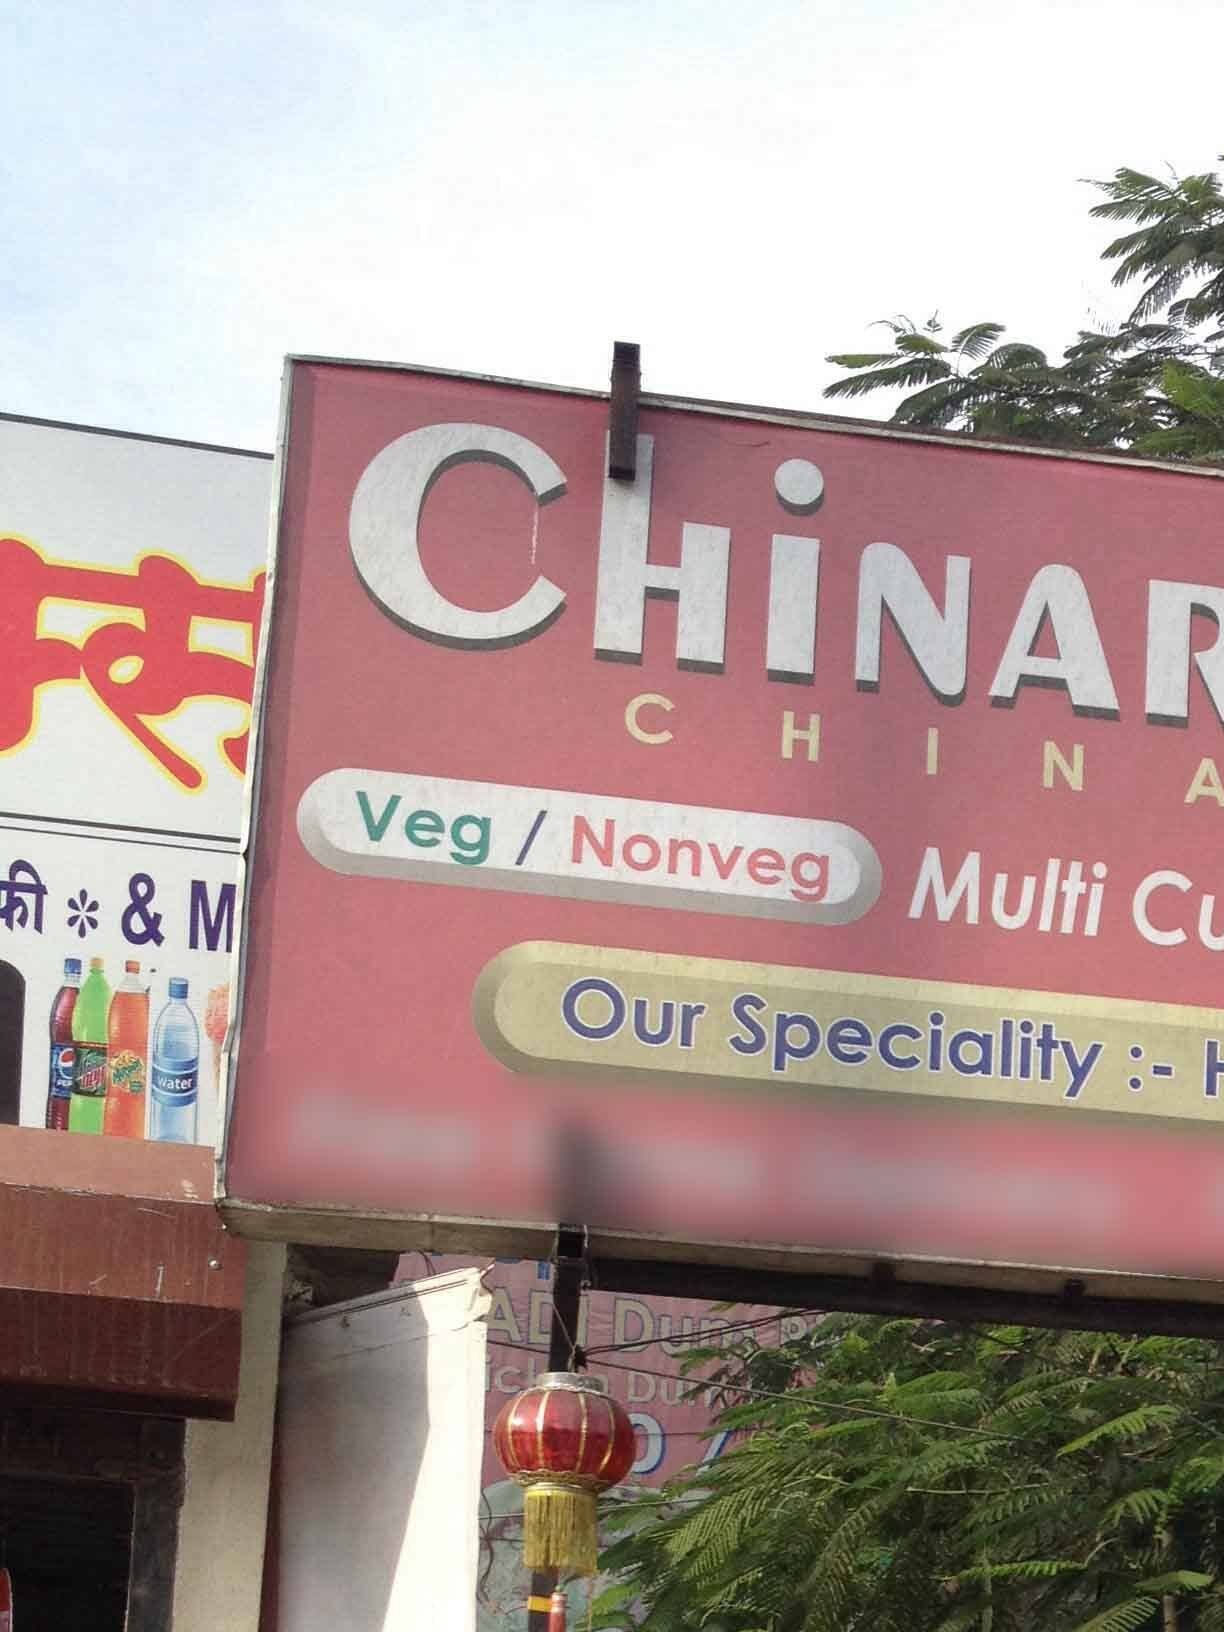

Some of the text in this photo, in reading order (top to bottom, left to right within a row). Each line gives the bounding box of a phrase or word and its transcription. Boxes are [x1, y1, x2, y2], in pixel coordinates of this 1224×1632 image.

[355, 790, 492, 866] Veg
[571, 815, 831, 903] Nonveg
[908, 845, 1108, 938] Multi
[121, 872, 165, 946] &
[562, 975, 705, 1050] Our
[728, 992, 1104, 1101] Speciality
